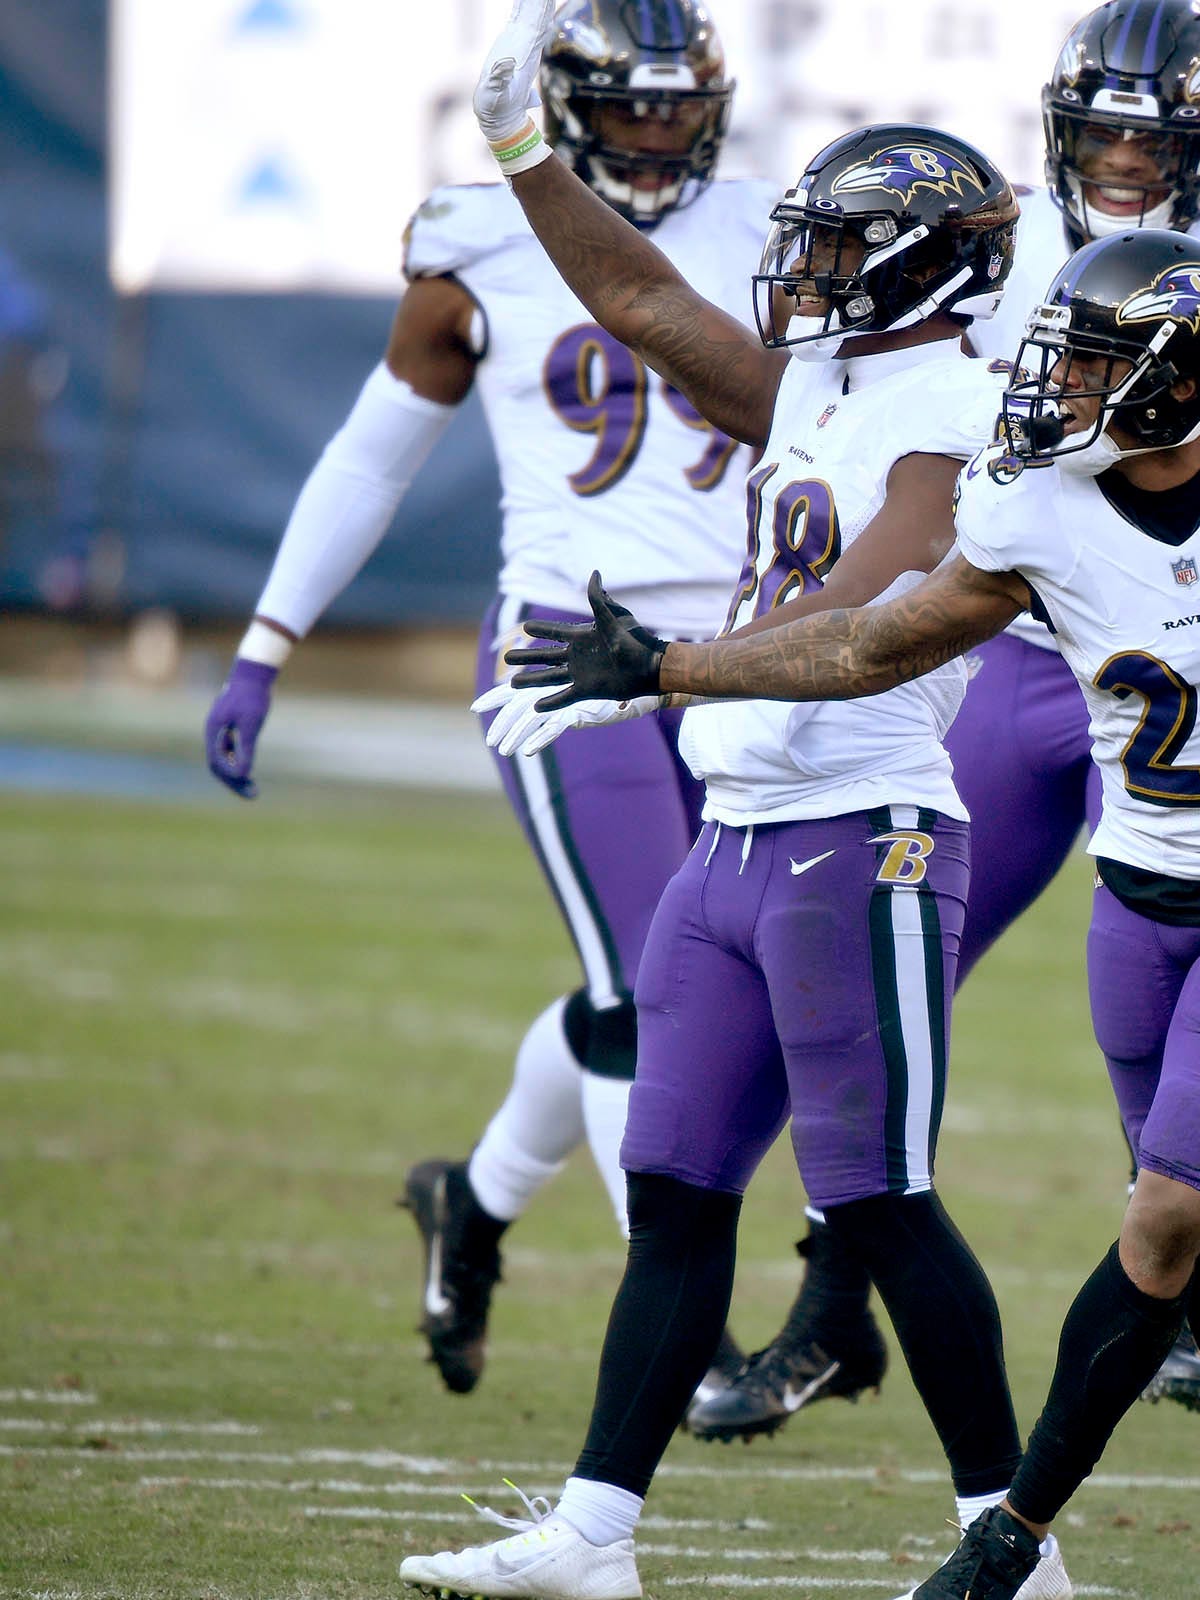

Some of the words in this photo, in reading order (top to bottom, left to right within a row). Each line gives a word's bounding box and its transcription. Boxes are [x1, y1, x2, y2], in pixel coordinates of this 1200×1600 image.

[788, 446, 815, 464] RAVENS
[1176, 569, 1196, 583] NFL
[864, 830, 934, 884] B
